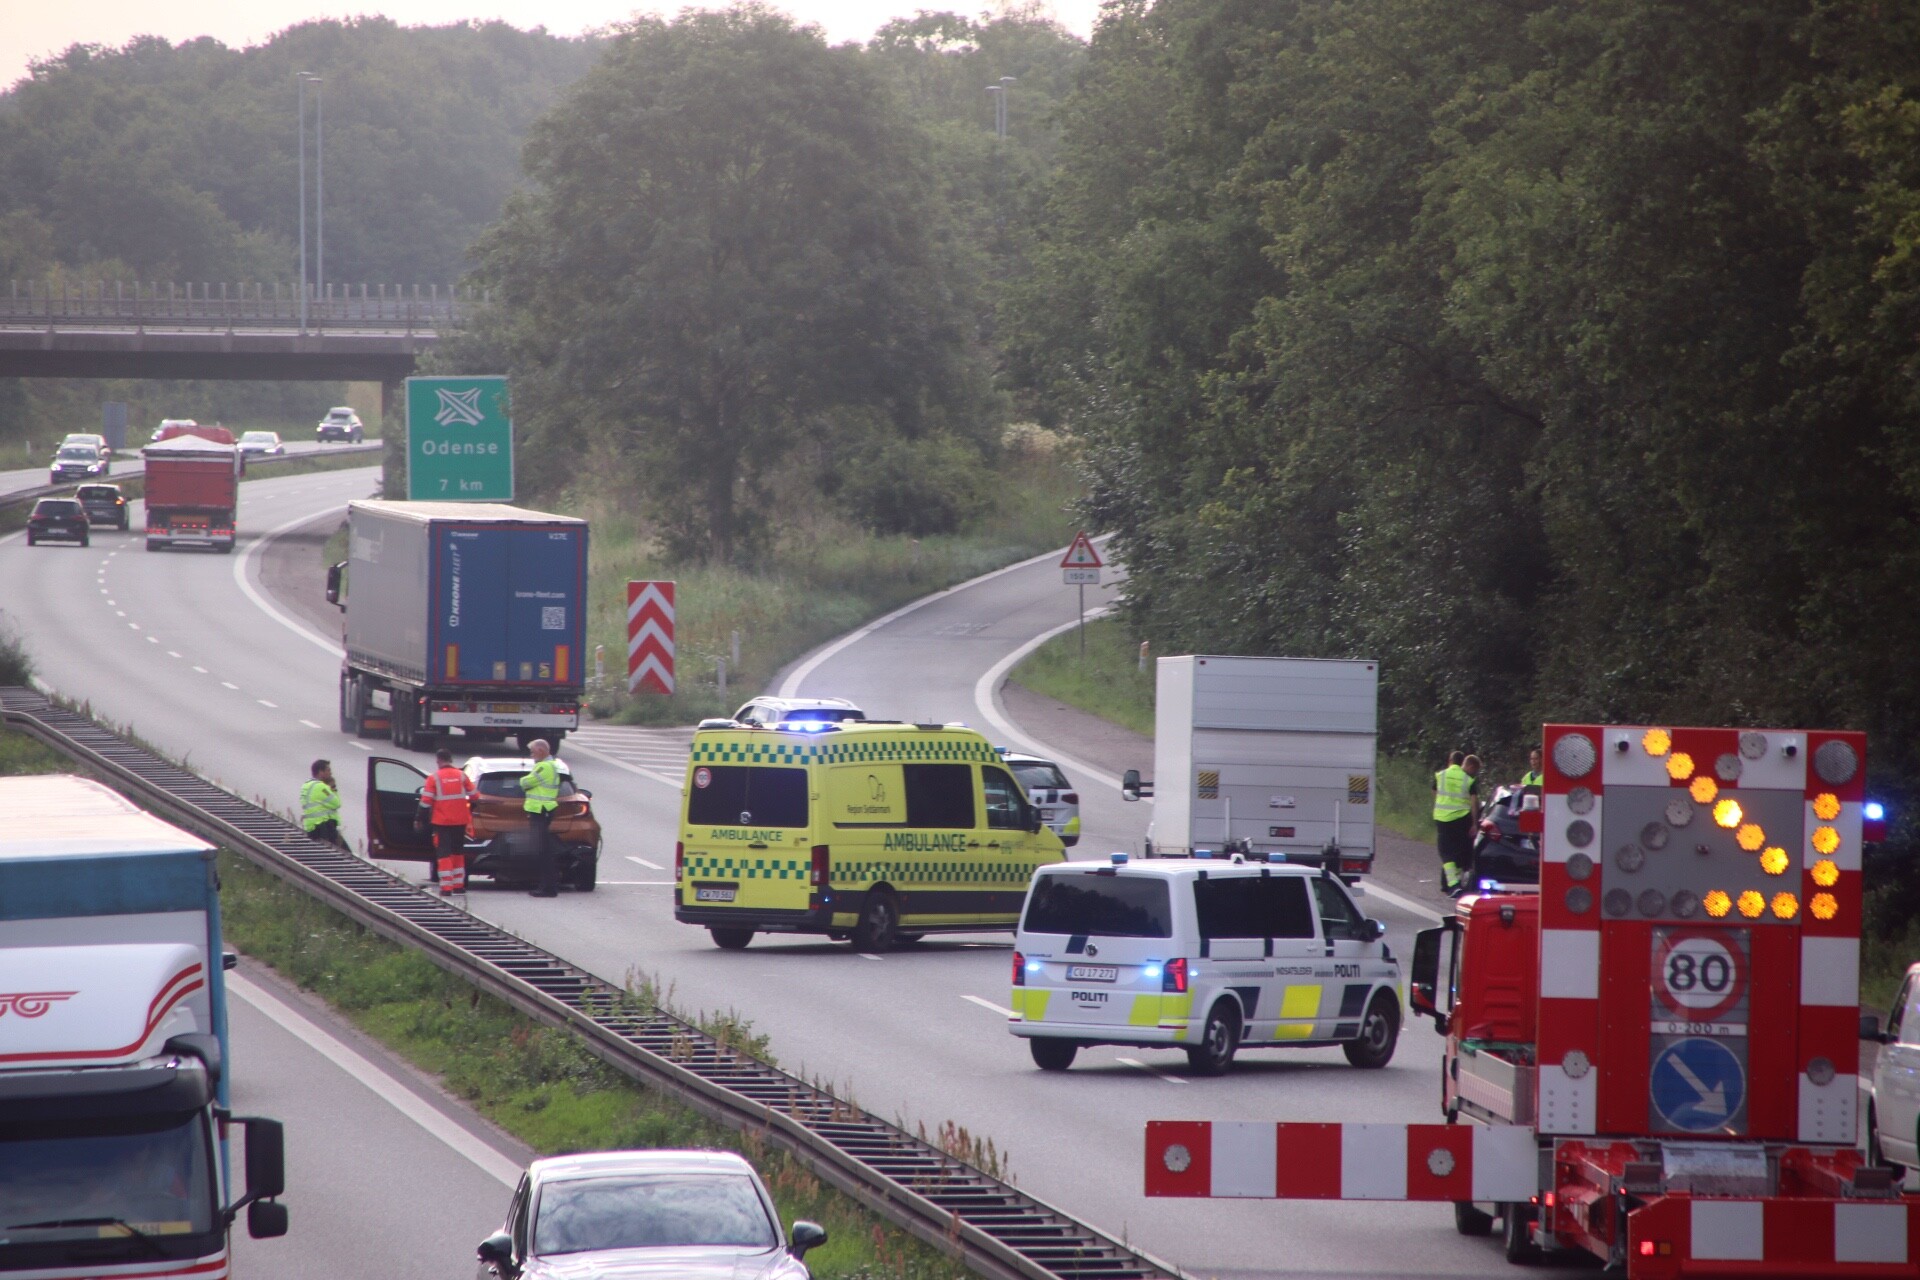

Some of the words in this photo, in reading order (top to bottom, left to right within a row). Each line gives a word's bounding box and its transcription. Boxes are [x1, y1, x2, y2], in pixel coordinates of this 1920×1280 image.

[422, 440, 498, 455] Odense
[439, 479, 449, 491] 7
[459, 479, 484, 491] km
[453, 552, 461, 574] FLEET
[452, 575, 461, 615] KRONE
[493, 717, 524, 726] KRONE
[711, 829, 782, 842] AMBULANCE
[883, 833, 967, 852] AMBULANCE
[1073, 967, 1085, 977] CU
[1087, 967, 1097, 978] 17
[1099, 968, 1114, 979] 271
[1334, 964, 1361, 978] POLITI
[1669, 954, 1730, 992] 80
[1071, 991, 1109, 1002] POLITI
[1719, 1025, 1729, 1035] m
